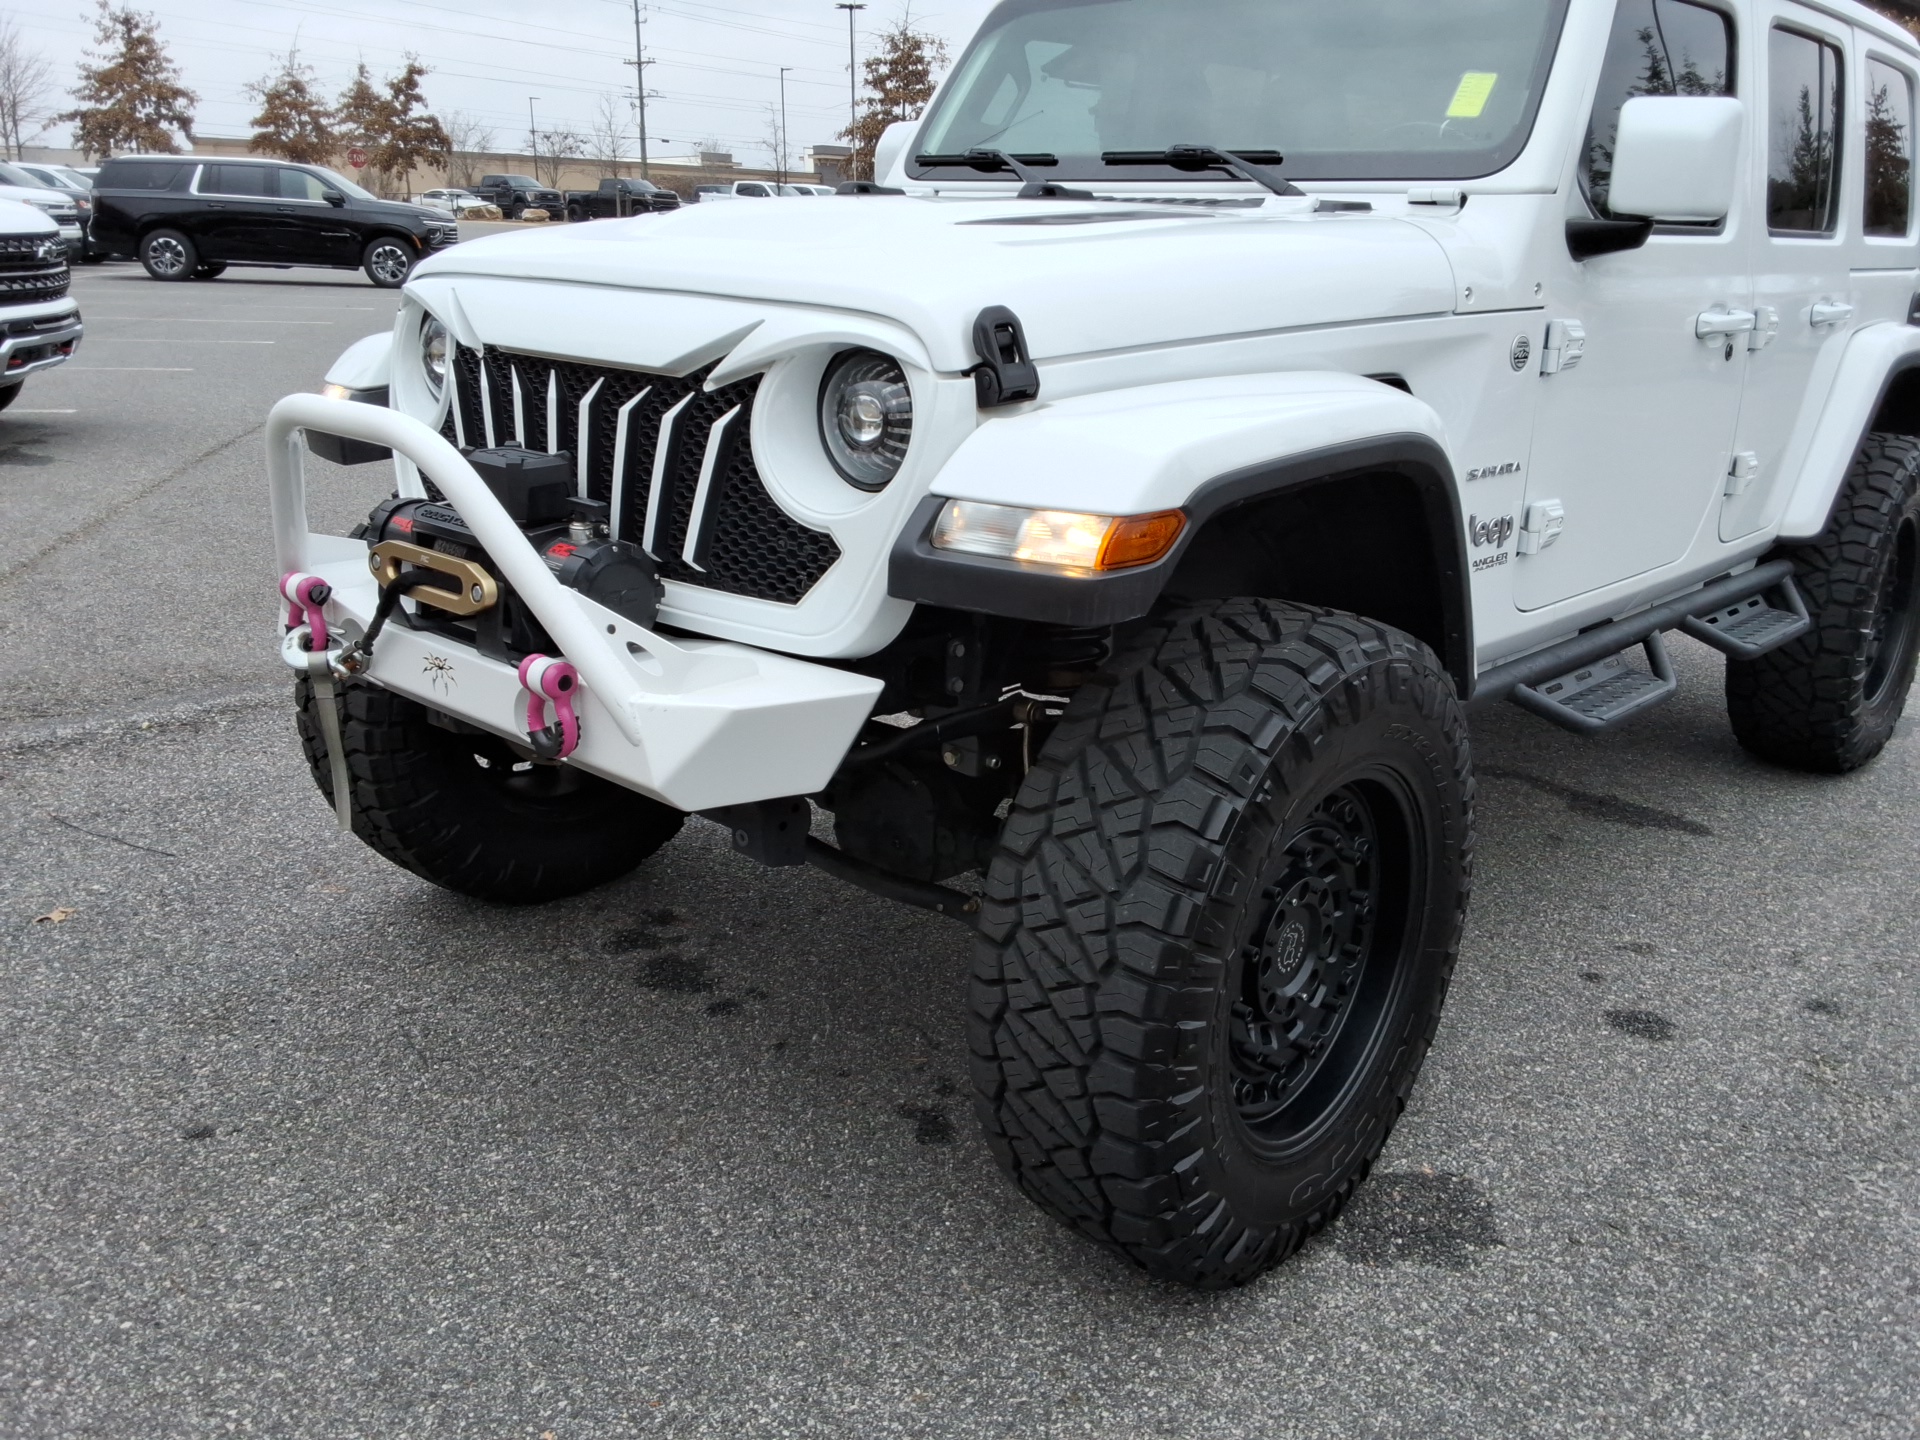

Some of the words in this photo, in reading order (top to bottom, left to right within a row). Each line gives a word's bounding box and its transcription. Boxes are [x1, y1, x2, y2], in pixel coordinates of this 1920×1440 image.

[348, 153, 366, 163] STOP
[1466, 461, 1521, 482] SAHARA
[1469, 513, 1514, 549] Jeep
